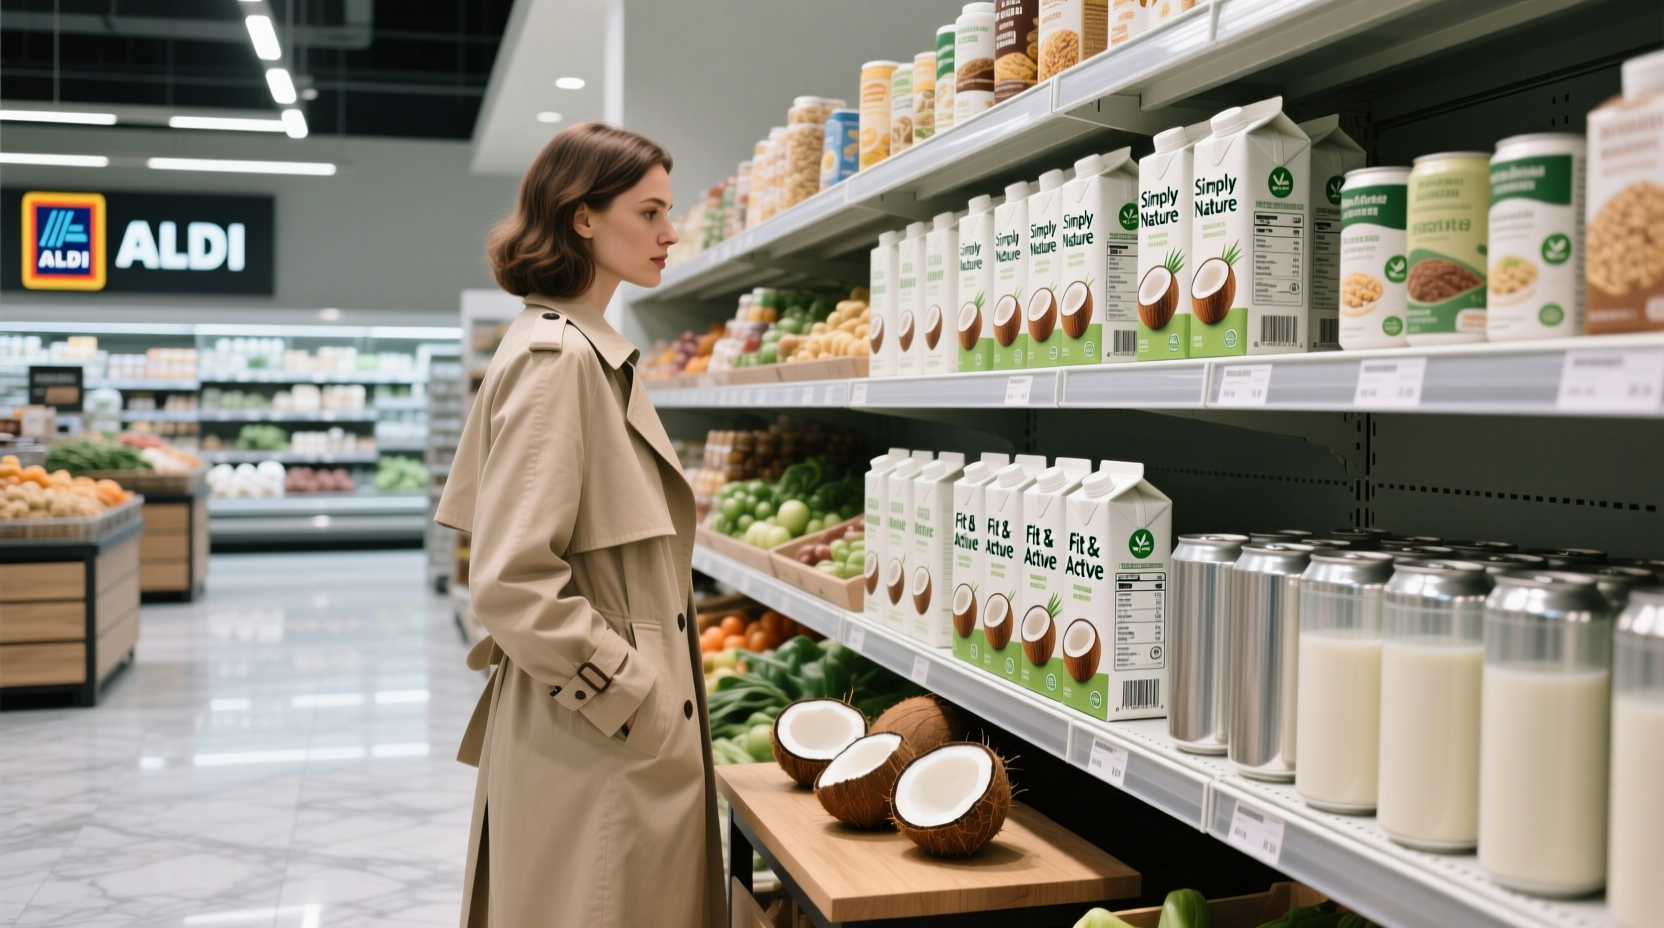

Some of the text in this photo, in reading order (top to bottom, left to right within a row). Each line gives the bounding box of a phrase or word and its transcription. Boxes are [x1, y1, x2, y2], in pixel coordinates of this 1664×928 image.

[1195, 173, 1237, 197] Simply
[1141, 186, 1179, 208] Simply
[1195, 198, 1237, 218] Nature
[1063, 210, 1094, 230] Simply
[1141, 210, 1179, 228] Nature
[1030, 220, 1057, 239] Simply
[115, 220, 246, 272] ALDI
[38, 249, 90, 269] ALDI
[955, 512, 967, 531] Fit
[987, 518, 1011, 539] Fit &
[1026, 524, 1054, 548] Fit &
[1069, 532, 1100, 558] Fit &
